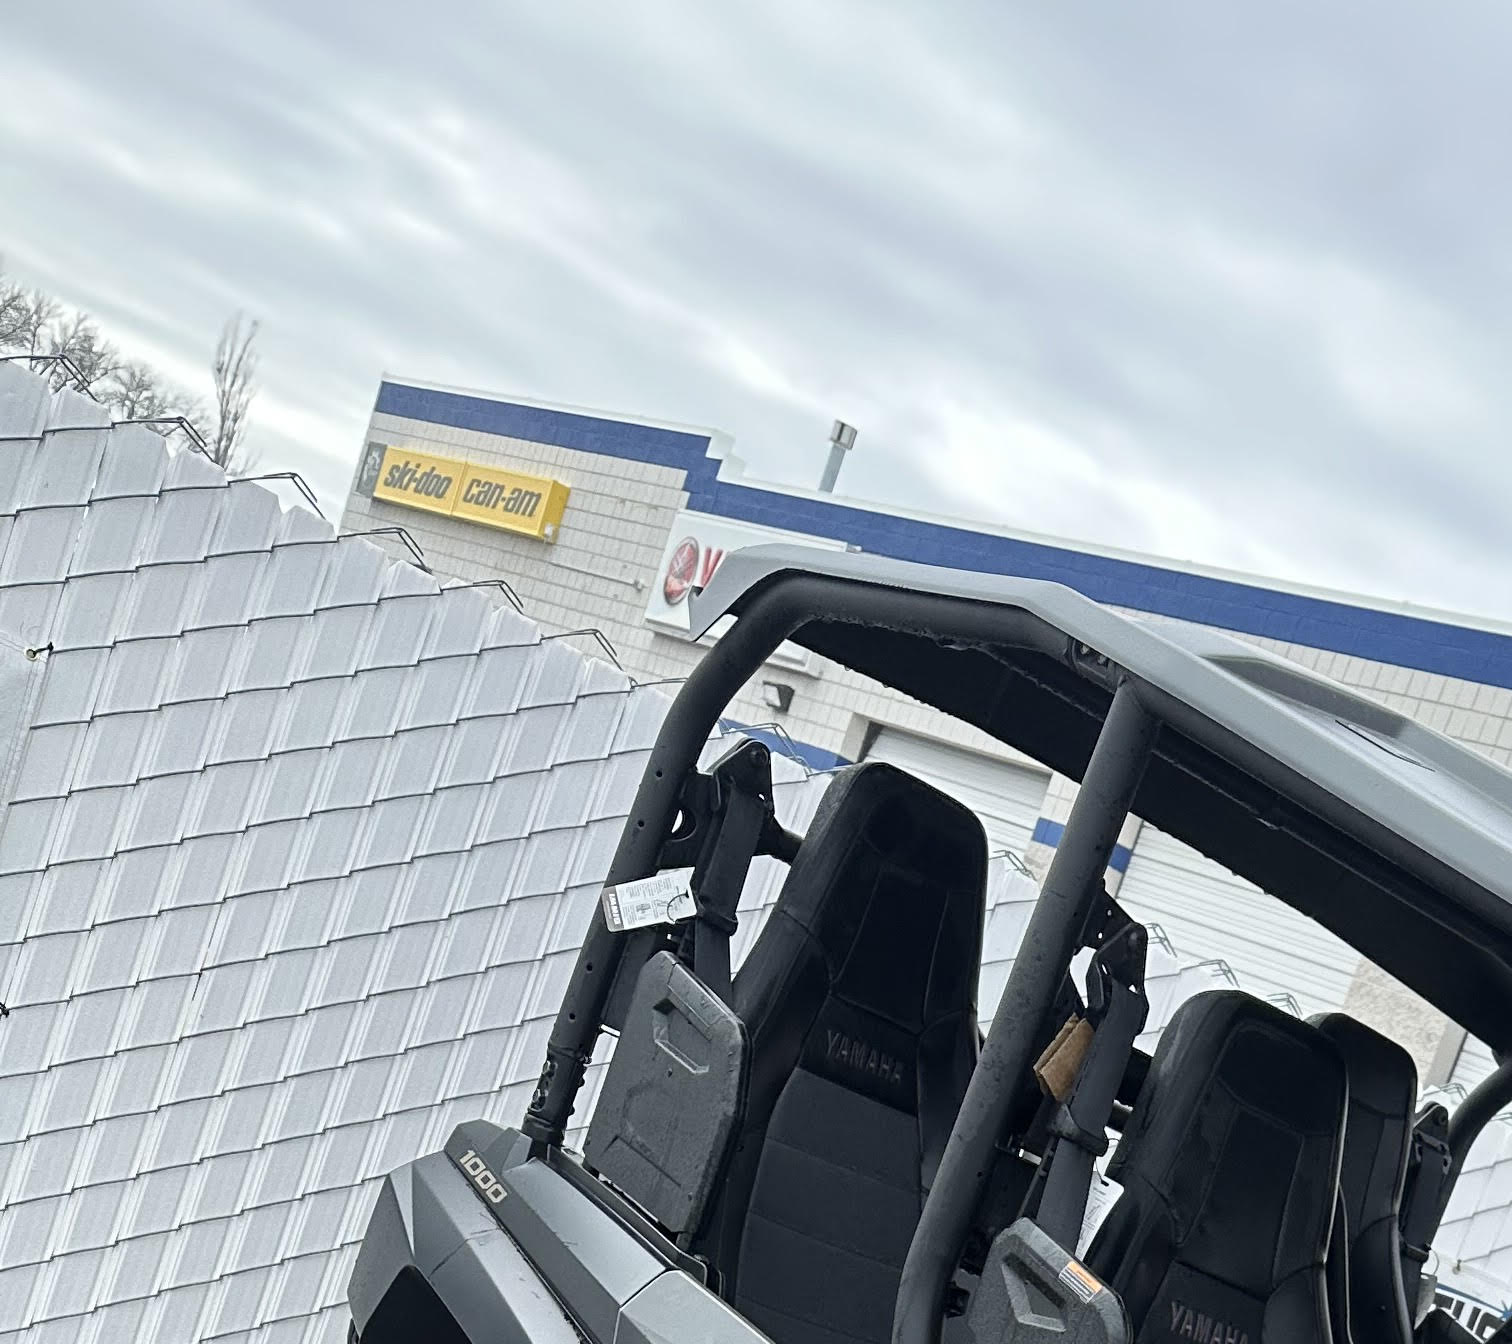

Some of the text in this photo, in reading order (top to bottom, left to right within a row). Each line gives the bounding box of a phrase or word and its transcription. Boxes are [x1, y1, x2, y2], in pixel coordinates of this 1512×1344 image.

[383, 460, 453, 500] ski-doo
[462, 478, 542, 518] can-am
[827, 1029, 903, 1086] YAMAHA
[459, 1149, 508, 1203] 1000
